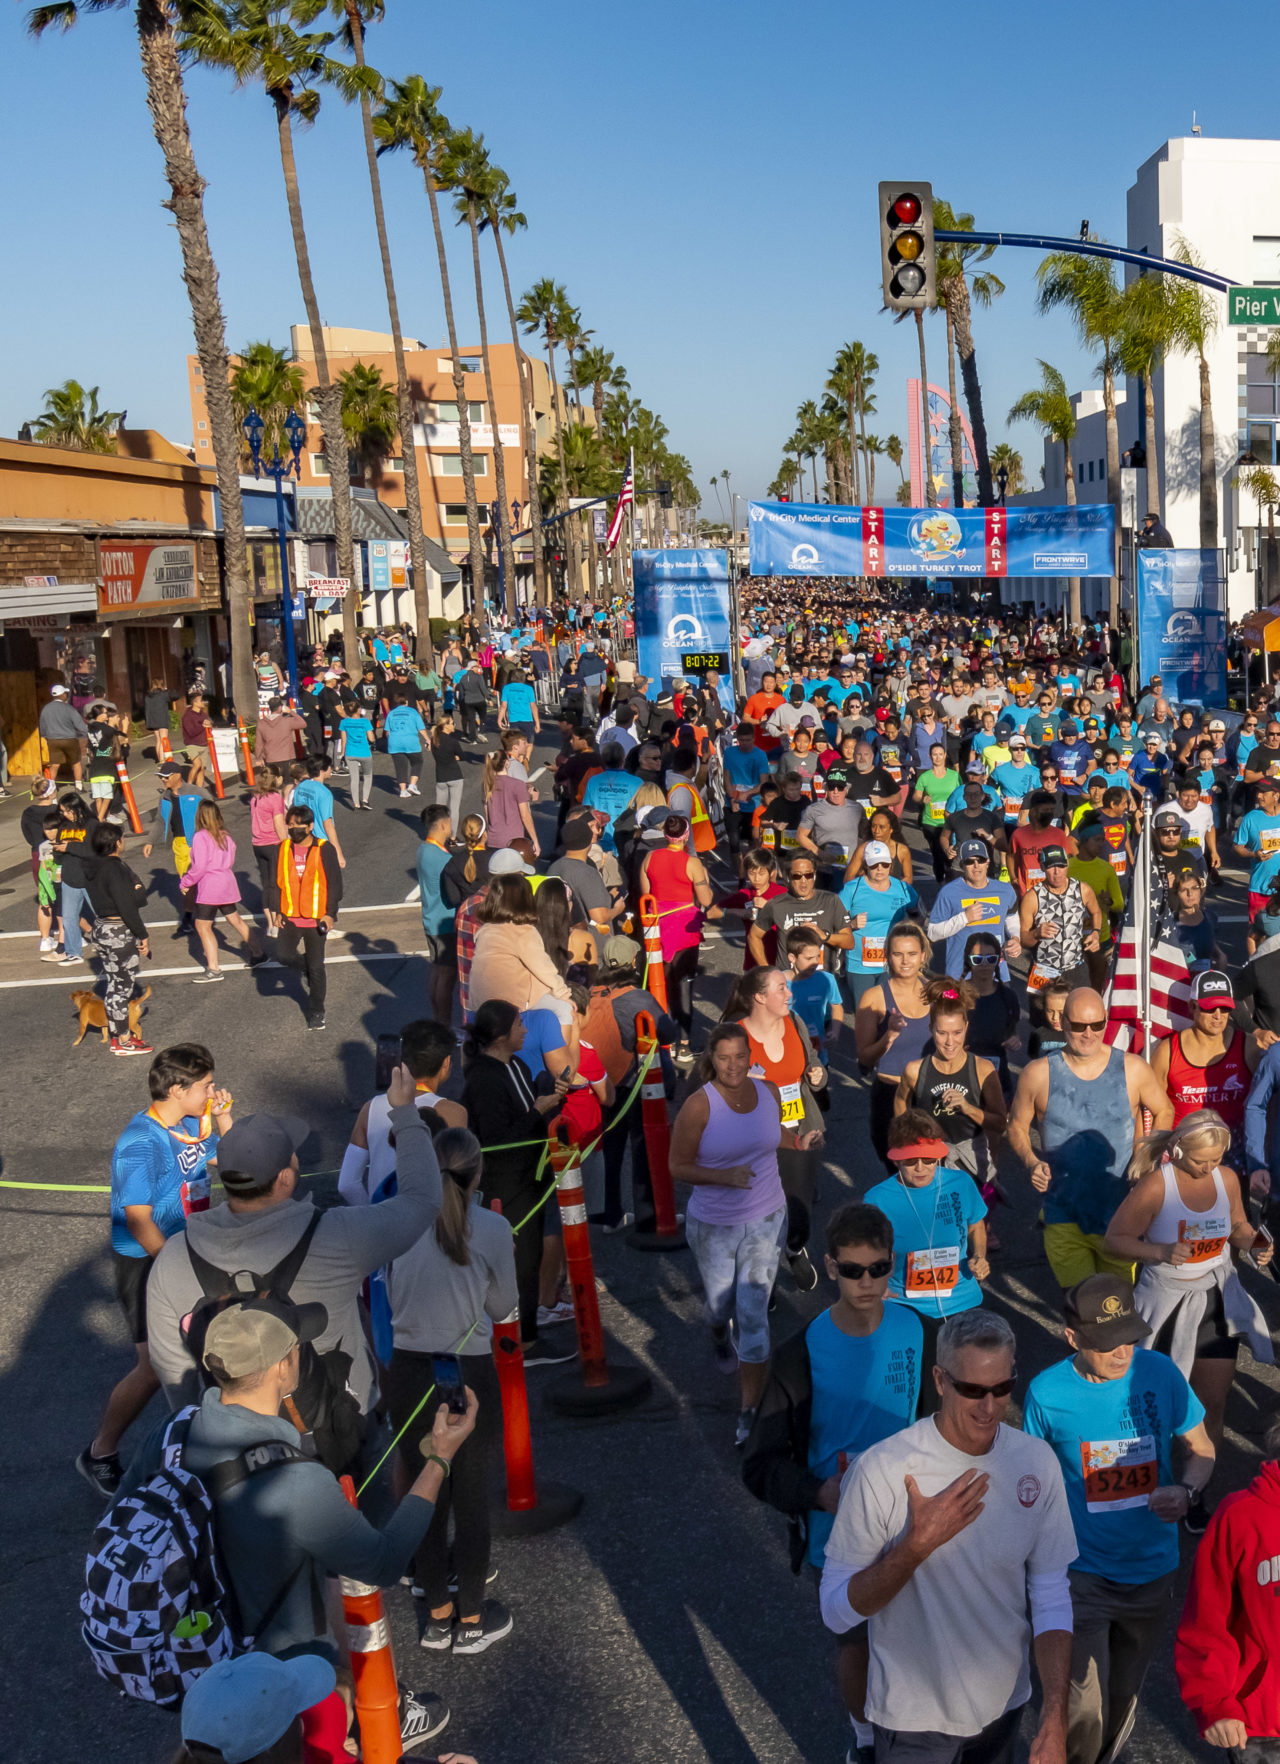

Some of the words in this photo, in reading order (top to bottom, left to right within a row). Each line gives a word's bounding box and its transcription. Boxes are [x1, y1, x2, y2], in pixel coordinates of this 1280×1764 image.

[1235, 296, 1268, 316] Pier
[767, 513, 796, 524] Tri-City
[798, 514, 831, 523] Medical
[832, 515, 861, 524] Center
[868, 509, 879, 572] START
[991, 512, 1002, 572] START
[100, 551, 135, 576] COTTON
[888, 564, 918, 572] O'SIDE
[957, 564, 982, 572] TROT
[1036, 556, 1085, 564] FRONTWAVE
[107, 580, 133, 604] PATCH
[308, 579, 350, 587] BREAKFAST
[1175, 1092, 1229, 1104] SEMPER
[1181, 1085, 1218, 1095] Team
[177, 1141, 206, 1175] USA
[915, 1267, 954, 1286] 5242
[1118, 1446, 1139, 1454] Turkey
[1138, 1444, 1152, 1452] Trot
[1098, 1466, 1151, 1491] 5243
